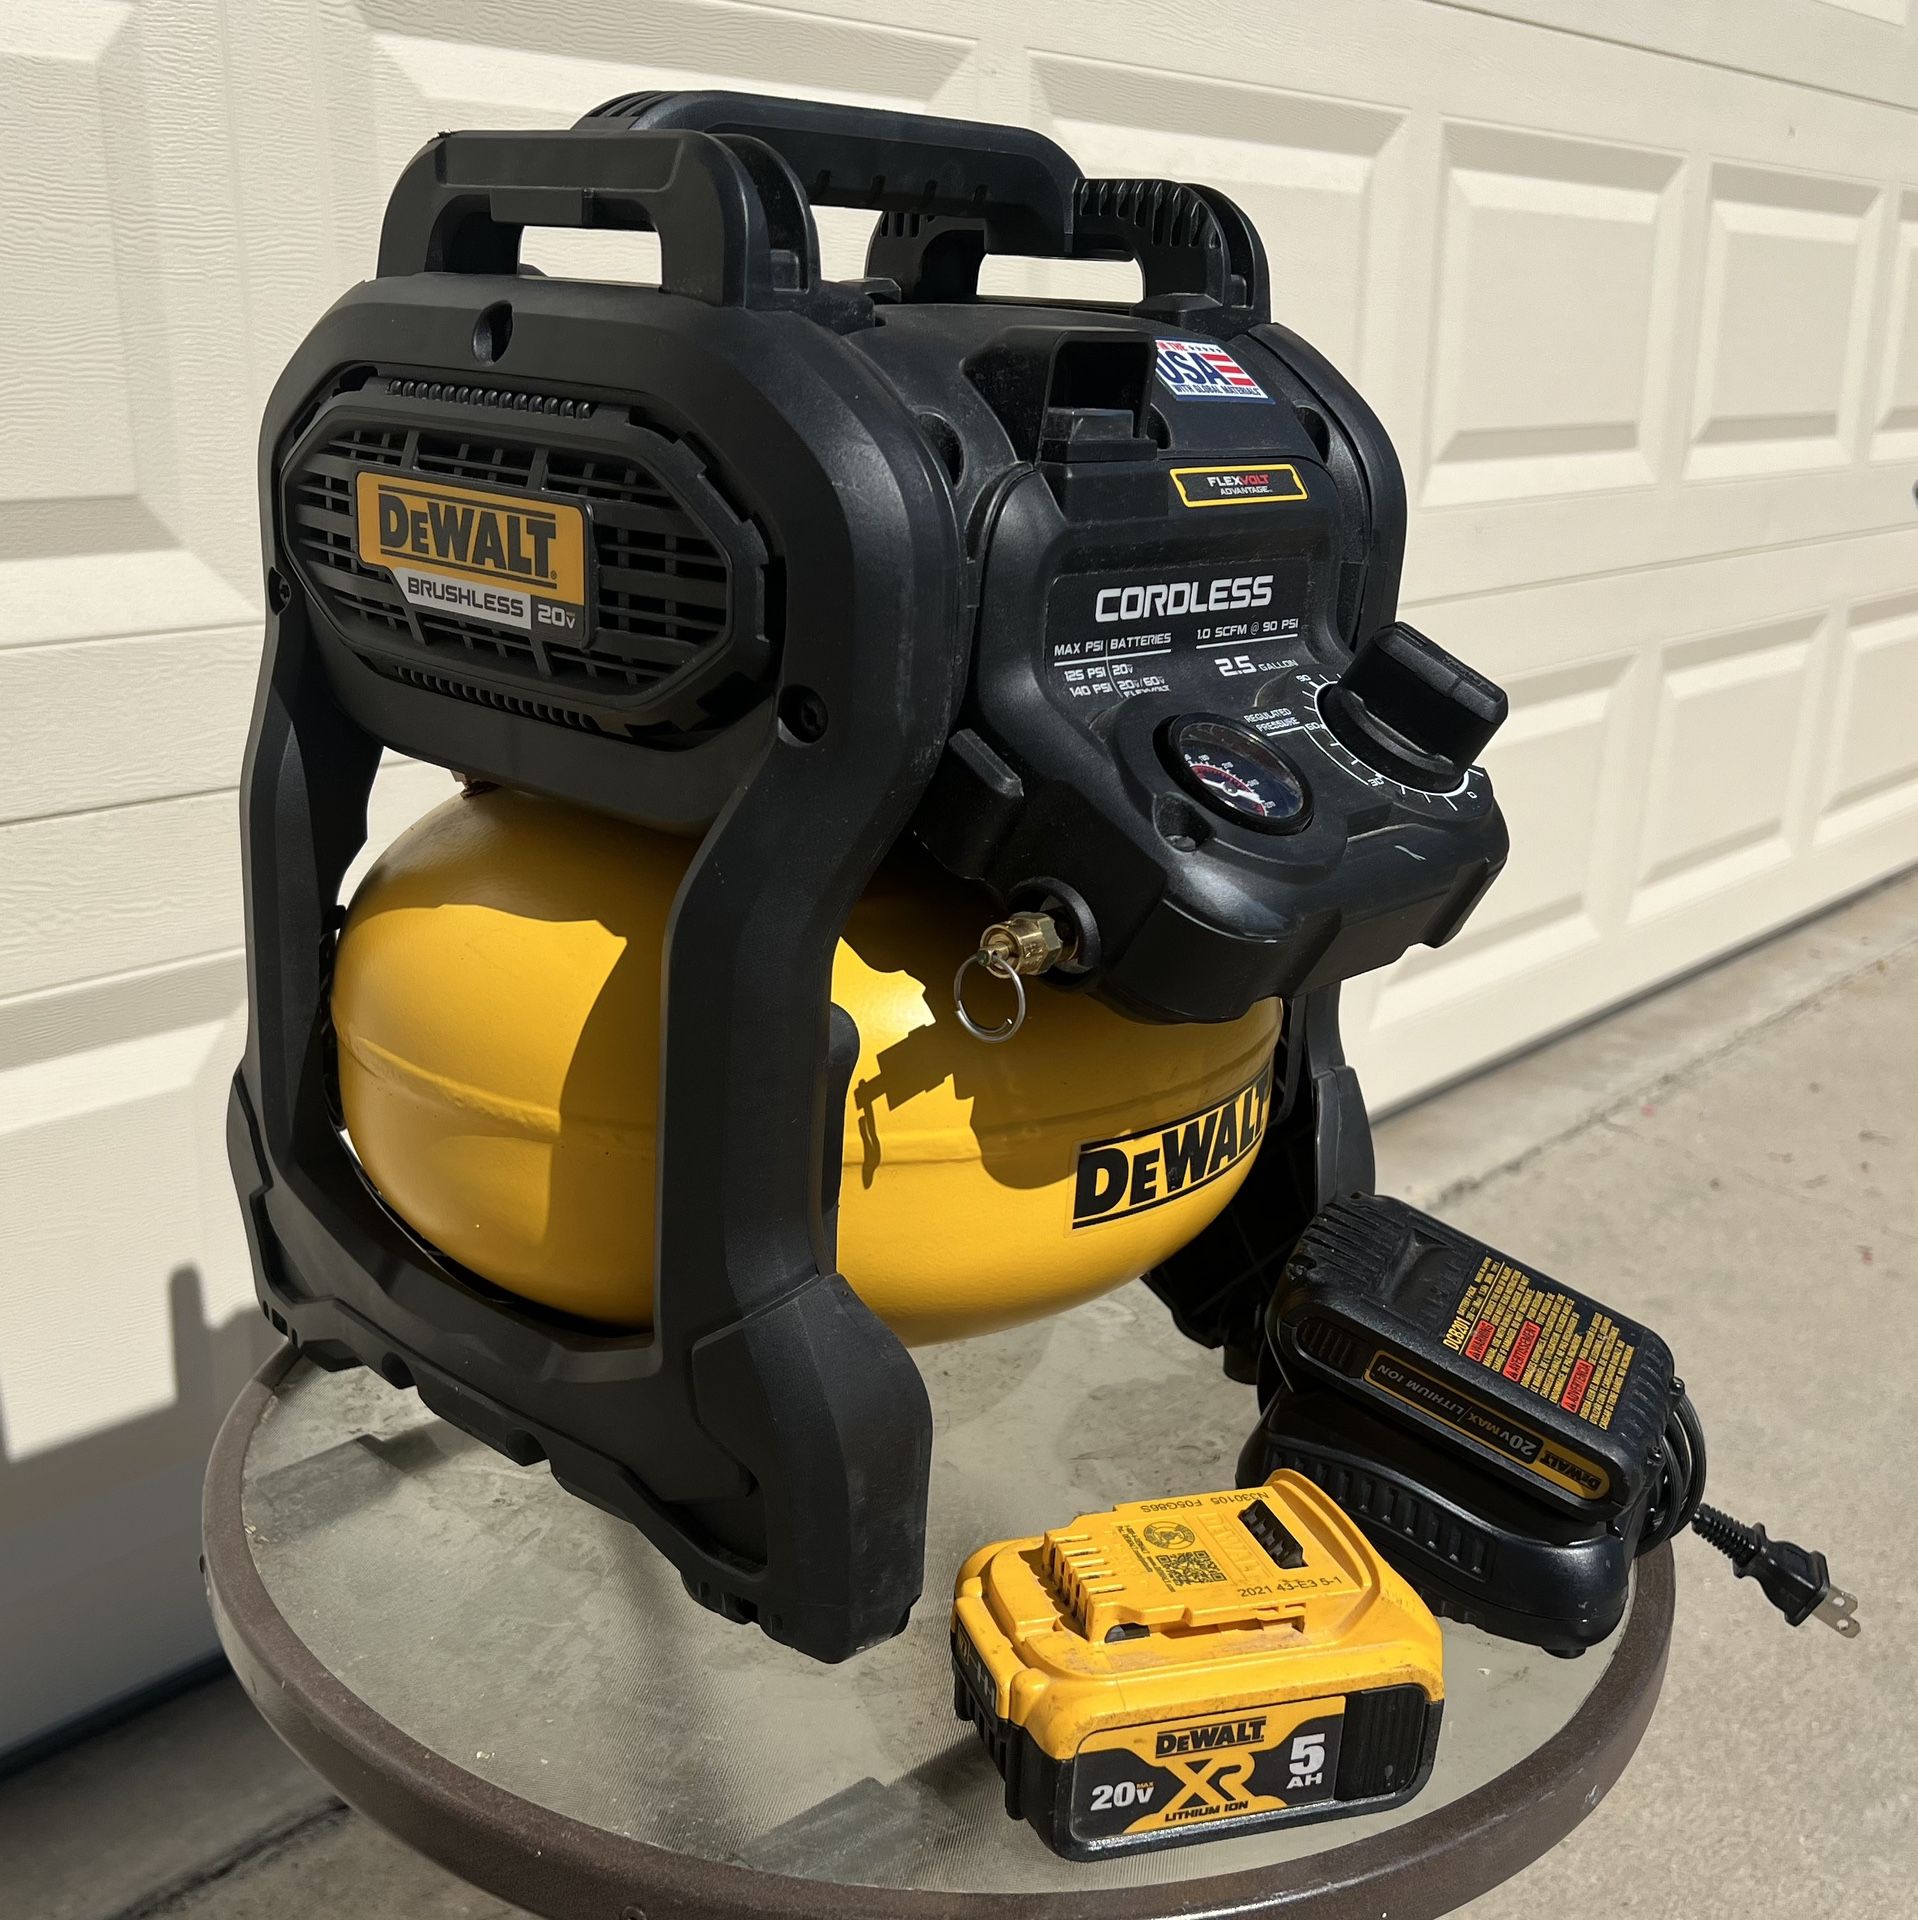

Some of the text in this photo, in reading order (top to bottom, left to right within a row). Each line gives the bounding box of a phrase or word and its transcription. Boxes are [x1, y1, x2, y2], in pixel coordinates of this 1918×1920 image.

[1156, 350, 1232, 386] USA
[1193, 385, 1223, 395] GLOBAL
[1206, 474, 1271, 488] FLEXVOLT
[407, 575, 525, 618] BRUSHLESS
[1095, 575, 1274, 622] CORDLESS
[1196, 618, 1299, 640] 1.0 SCFM @ 90 PSI
[1054, 633, 1172, 656] MAX PSI BATTERIES
[1064, 669, 1085, 682] 125
[1087, 666, 1107, 679] PSI
[1214, 655, 1299, 677] 2.5 GALLON
[1069, 685, 1091, 698] 140
[1093, 683, 1113, 694] PSI
[1243, 707, 1292, 723] REGULATED
[1256, 716, 1300, 732] PRESSURE
[1304, 722, 1321, 731] 60
[1367, 778, 1385, 788] 30
[1441, 1315, 1471, 1351] DCB201
[1469, 1321, 1494, 1354] WARNING
[1506, 1321, 1539, 1373] AVERTISSEMENT
[1377, 1363, 1402, 1383] ION
[1564, 1359, 1591, 1404] ADVERTENCIA
[1405, 1378, 1464, 1416] LITHIUM
[1467, 1410, 1501, 1435] MAX
[1140, 1491, 1270, 1514] N330105 F05G86S
[1238, 1585, 1272, 1598] 2021
[1289, 1733, 1326, 1776] 5
[1160, 1752, 1256, 1810] XR
[1286, 1772, 1323, 1790] AH
[1164, 1800, 1249, 1822] LITHIUM ION
